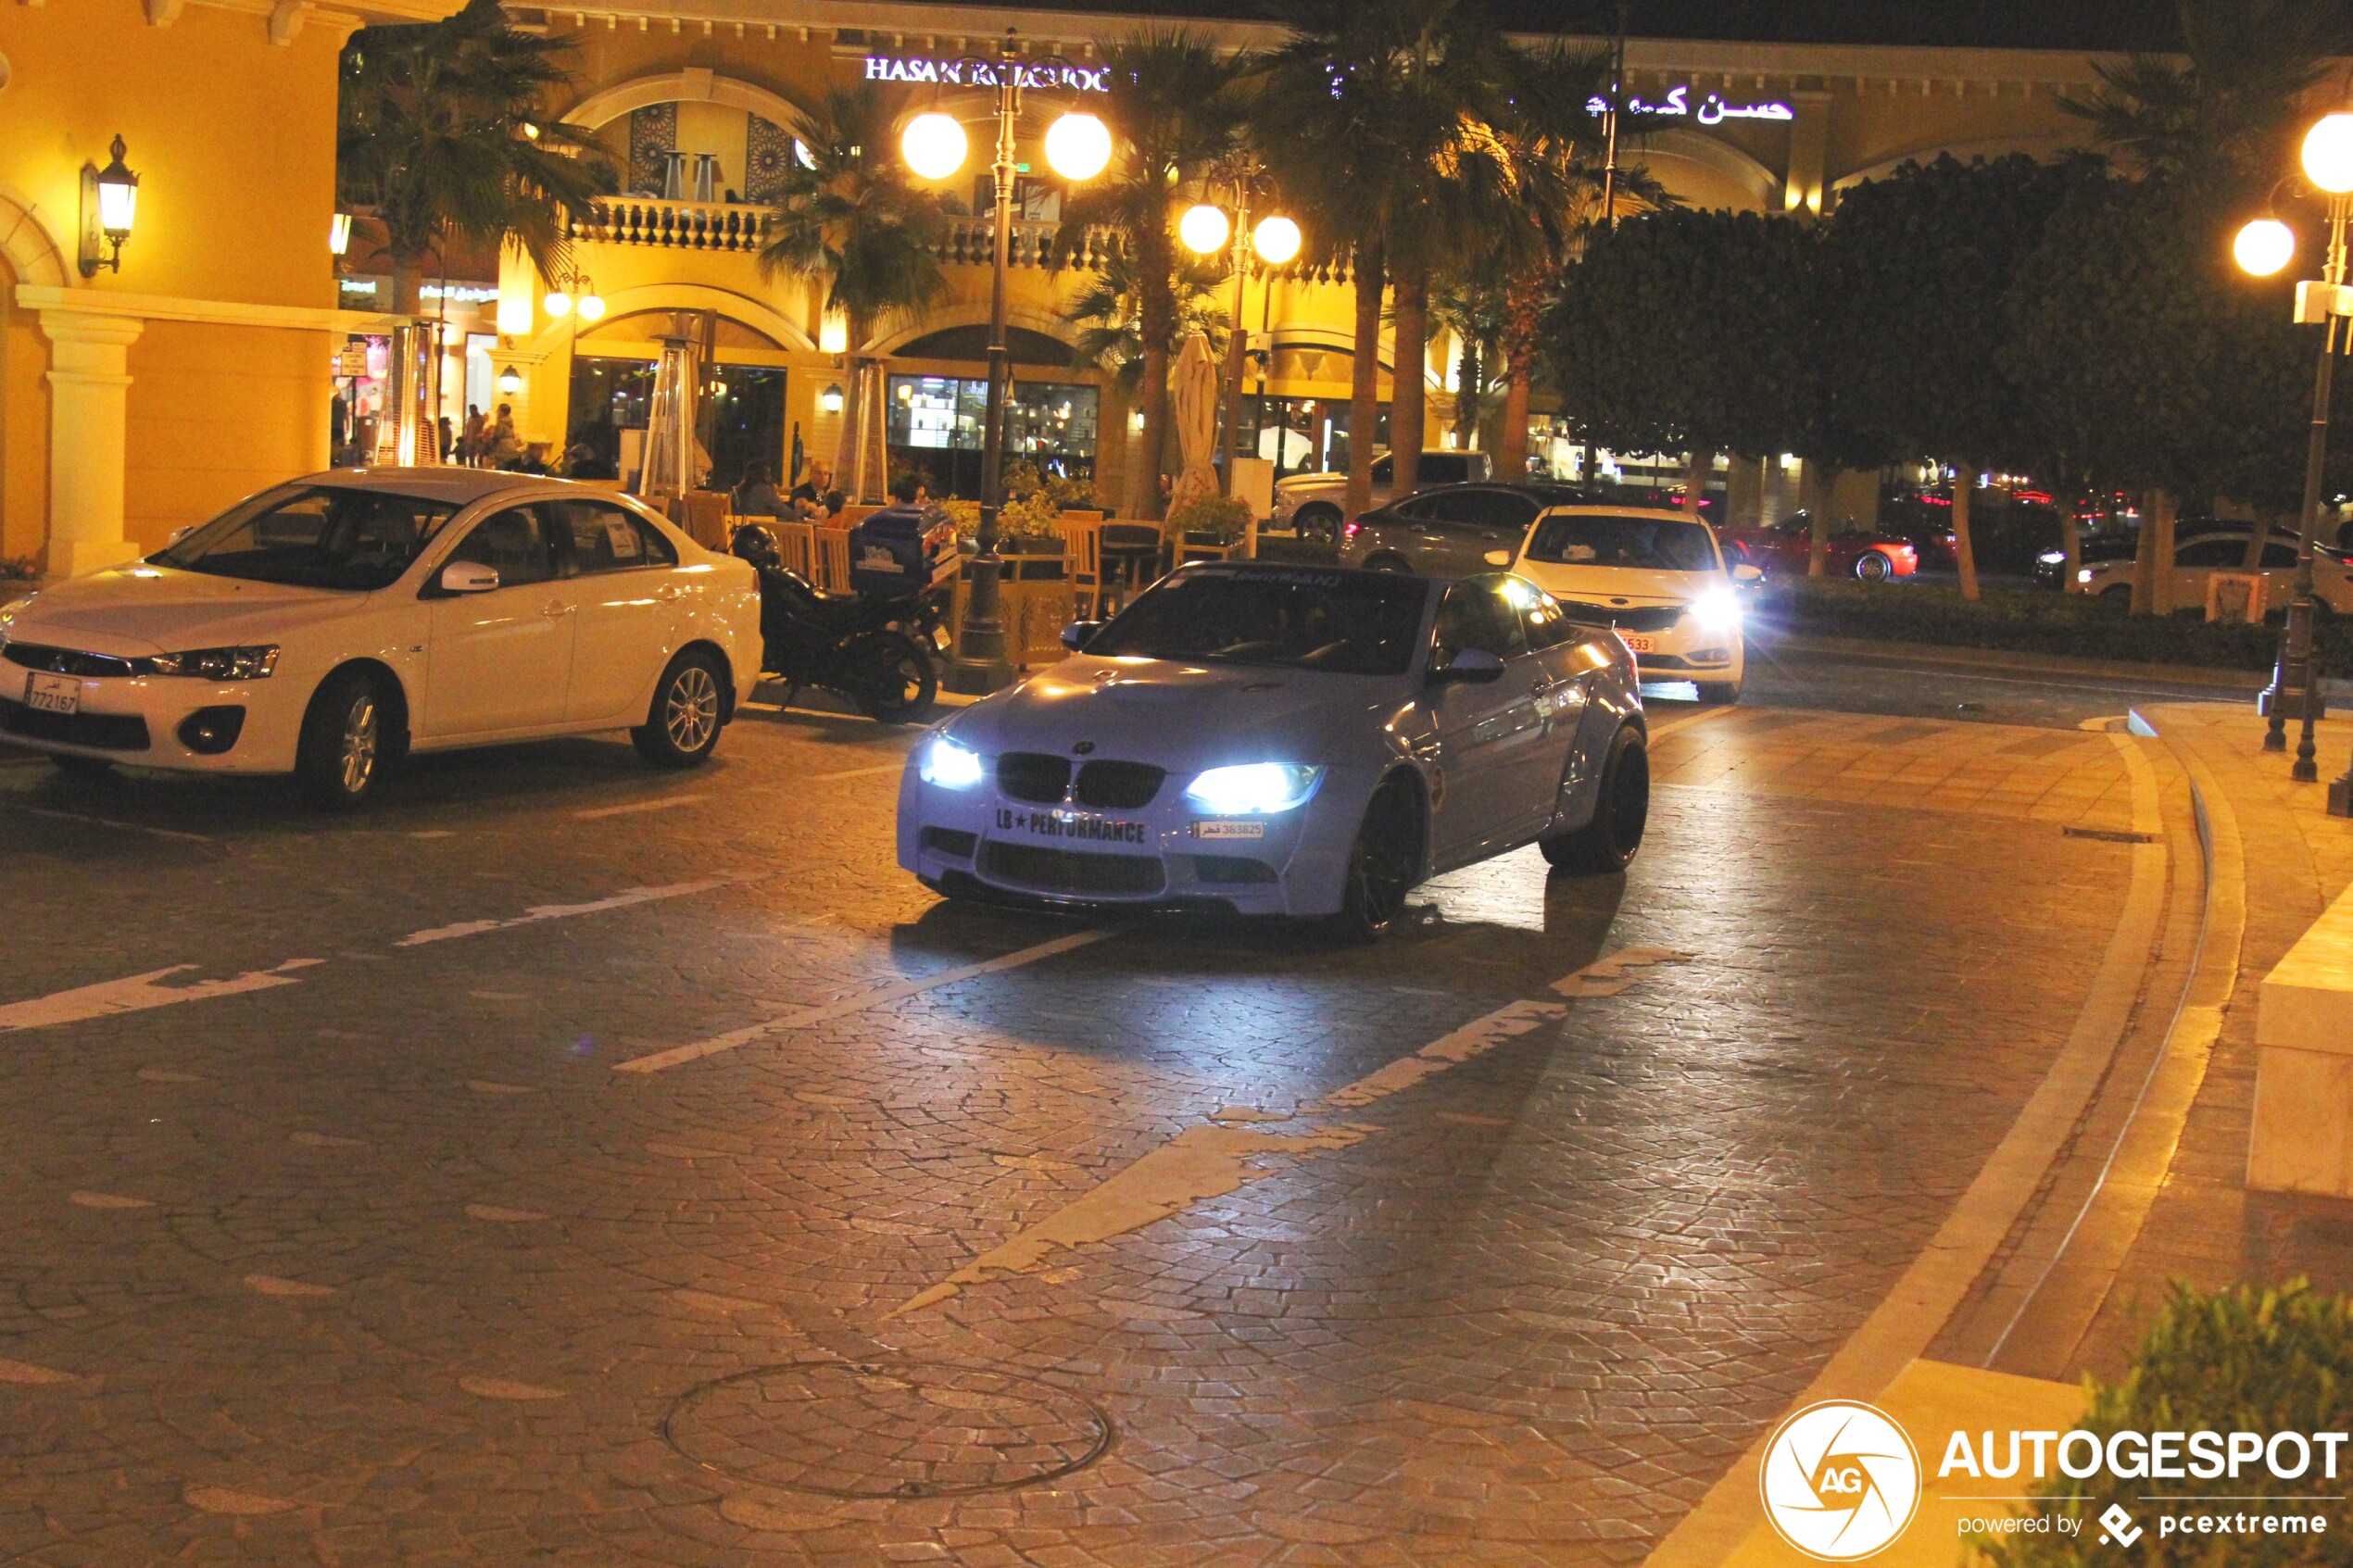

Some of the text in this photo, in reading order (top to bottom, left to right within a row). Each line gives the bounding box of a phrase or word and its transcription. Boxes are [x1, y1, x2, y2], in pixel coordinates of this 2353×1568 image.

[865, 56, 963, 84] HASAN
[1697, 94, 1793, 124] حسن
[1622, 637, 1649, 650] 533
[31, 690, 76, 712] 772167
[996, 808, 1145, 845] LB PERFORMANCE
[1222, 823, 1262, 835] 383825
